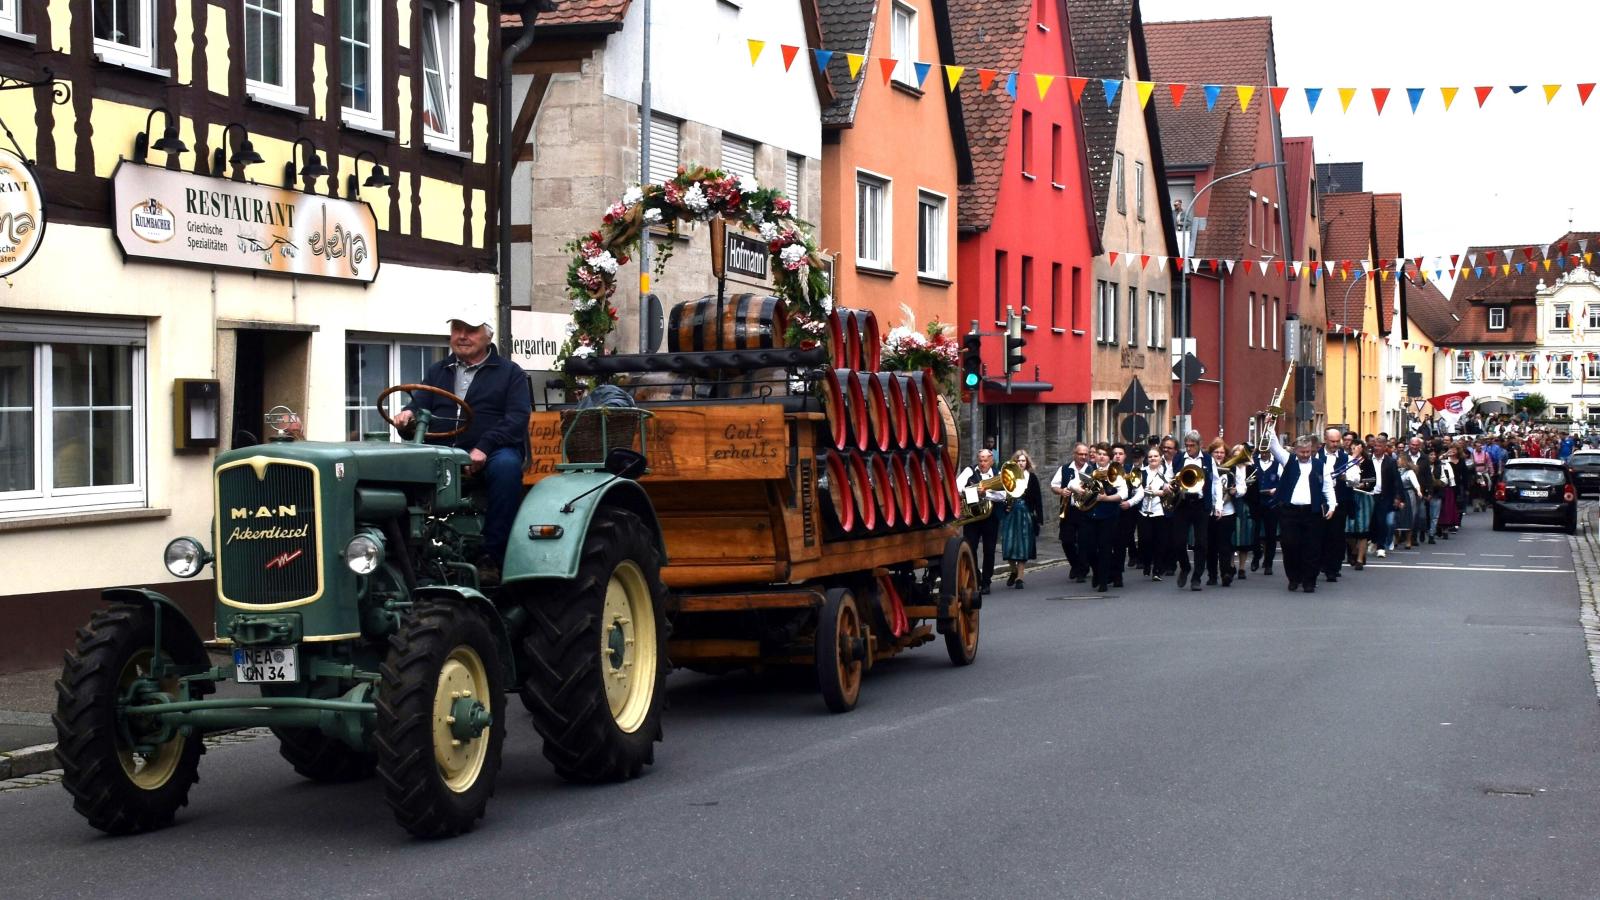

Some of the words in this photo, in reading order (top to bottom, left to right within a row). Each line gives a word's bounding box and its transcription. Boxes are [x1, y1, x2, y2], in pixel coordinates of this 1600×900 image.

[185, 187, 294, 228] RESTAURANT
[135, 213, 171, 231] KULMBACHER
[187, 220, 223, 236] Griechische
[187, 237, 228, 252] Spezialitäten
[308, 202, 368, 276] elena
[729, 238, 765, 274] Hofmann
[226, 523, 309, 545] Ackerdiesel
[244, 649, 273, 665] NEA
[268, 666, 285, 680] 34
